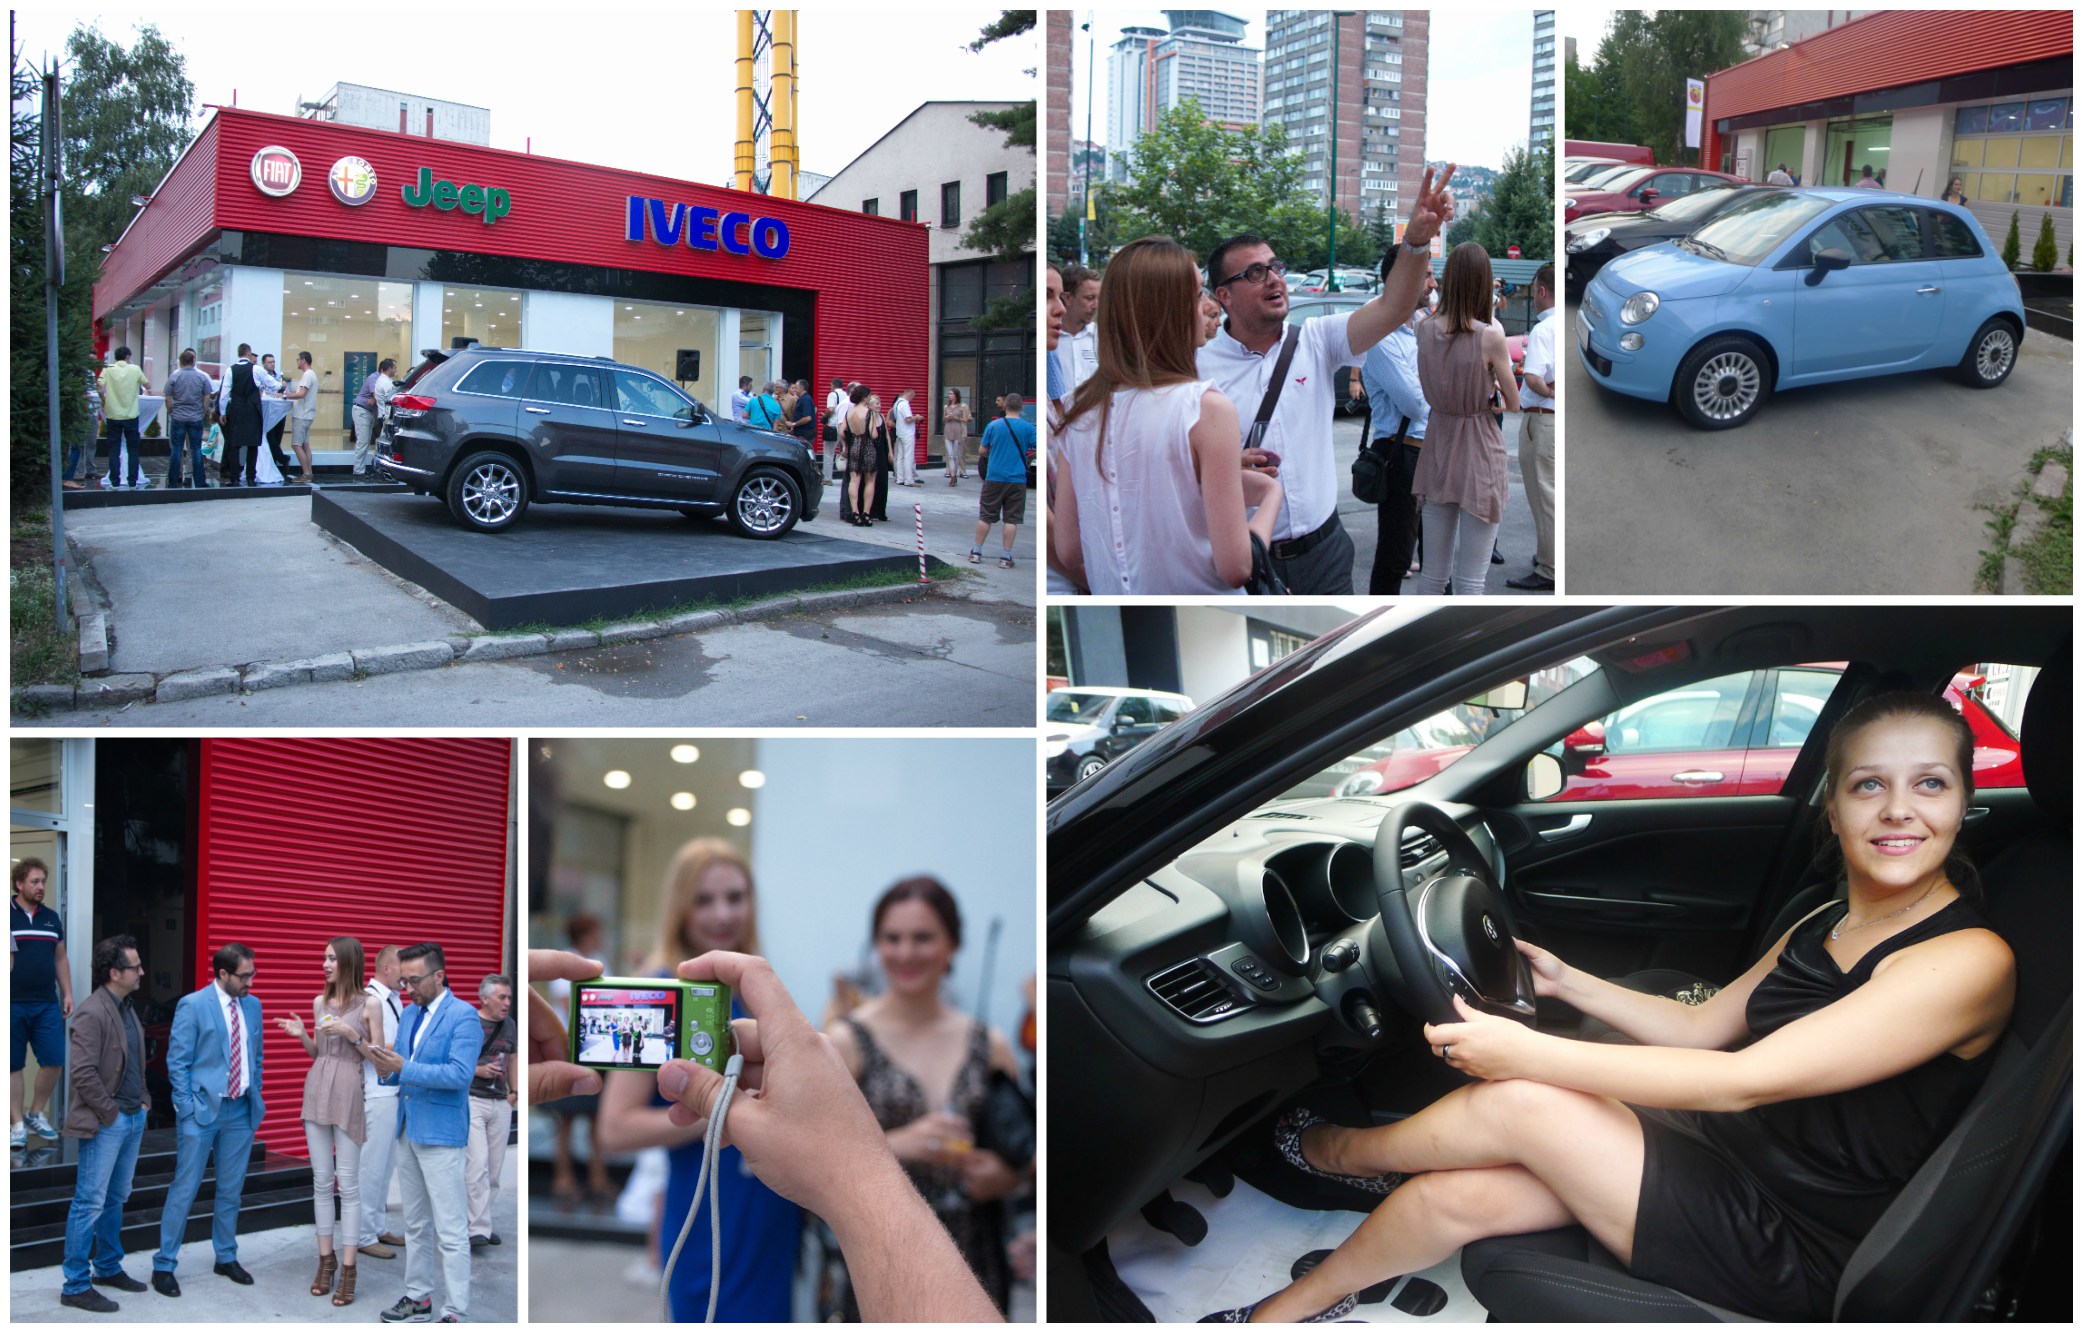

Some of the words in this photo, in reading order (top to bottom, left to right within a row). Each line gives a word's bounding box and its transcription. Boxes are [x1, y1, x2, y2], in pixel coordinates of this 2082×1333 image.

[263, 159, 292, 184] FIAT
[401, 167, 511, 224] Jeep
[625, 195, 790, 260] IVECO
[629, 990, 667, 1001] IVECO
